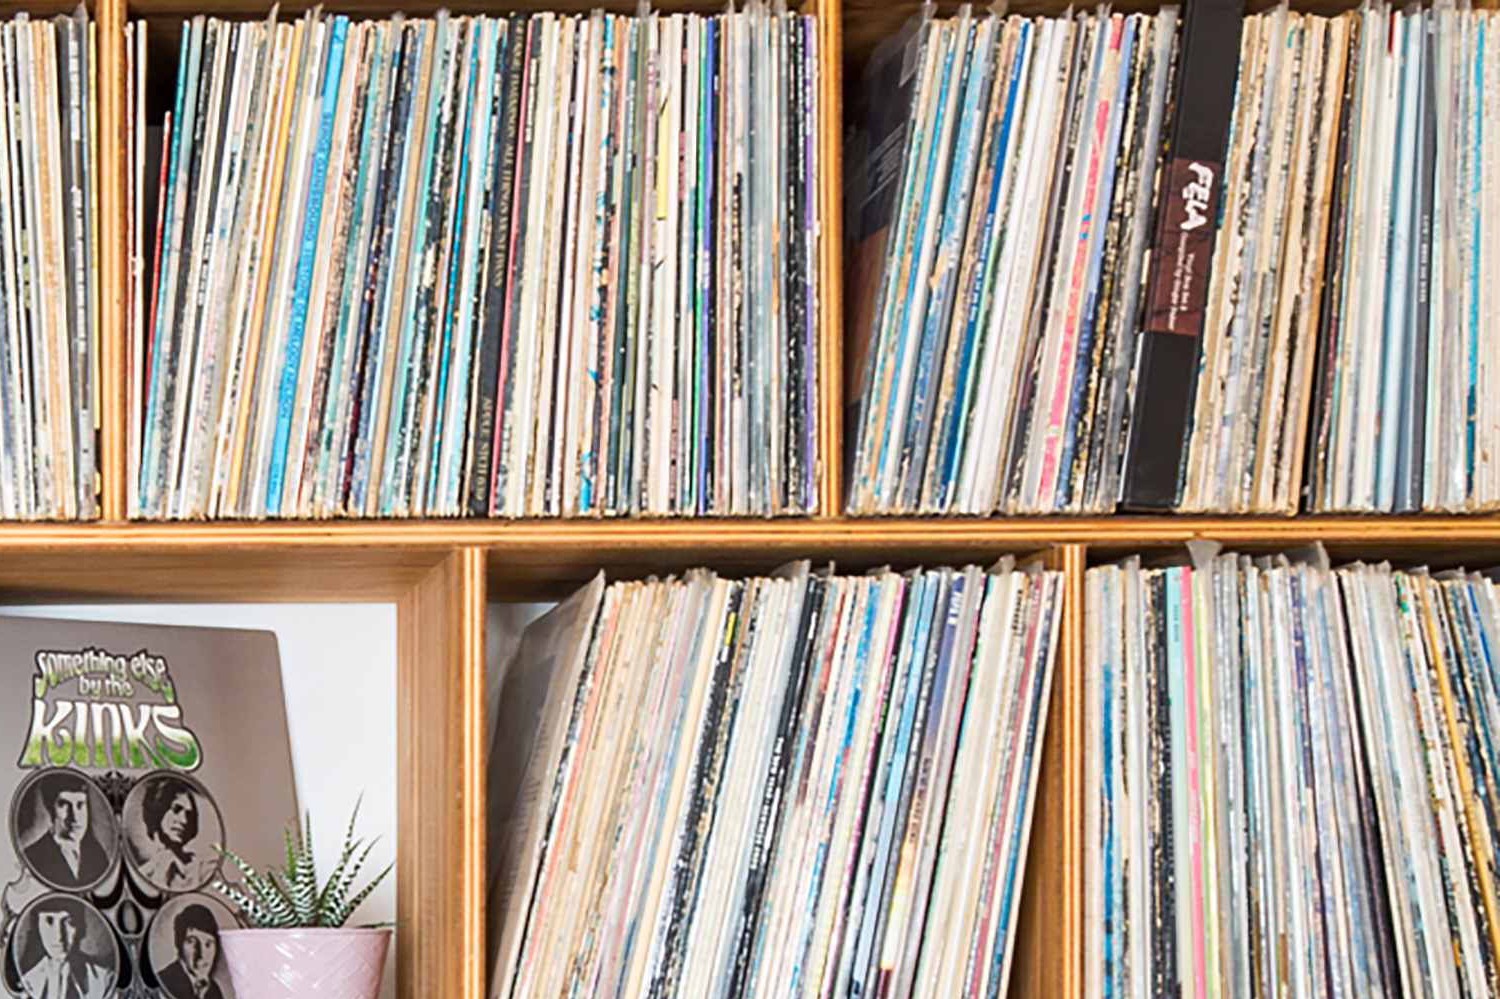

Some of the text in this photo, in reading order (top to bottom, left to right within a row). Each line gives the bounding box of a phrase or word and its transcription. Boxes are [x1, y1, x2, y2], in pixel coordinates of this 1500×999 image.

[1180, 162, 1214, 230] FELA
[78, 674, 134, 699] by the
